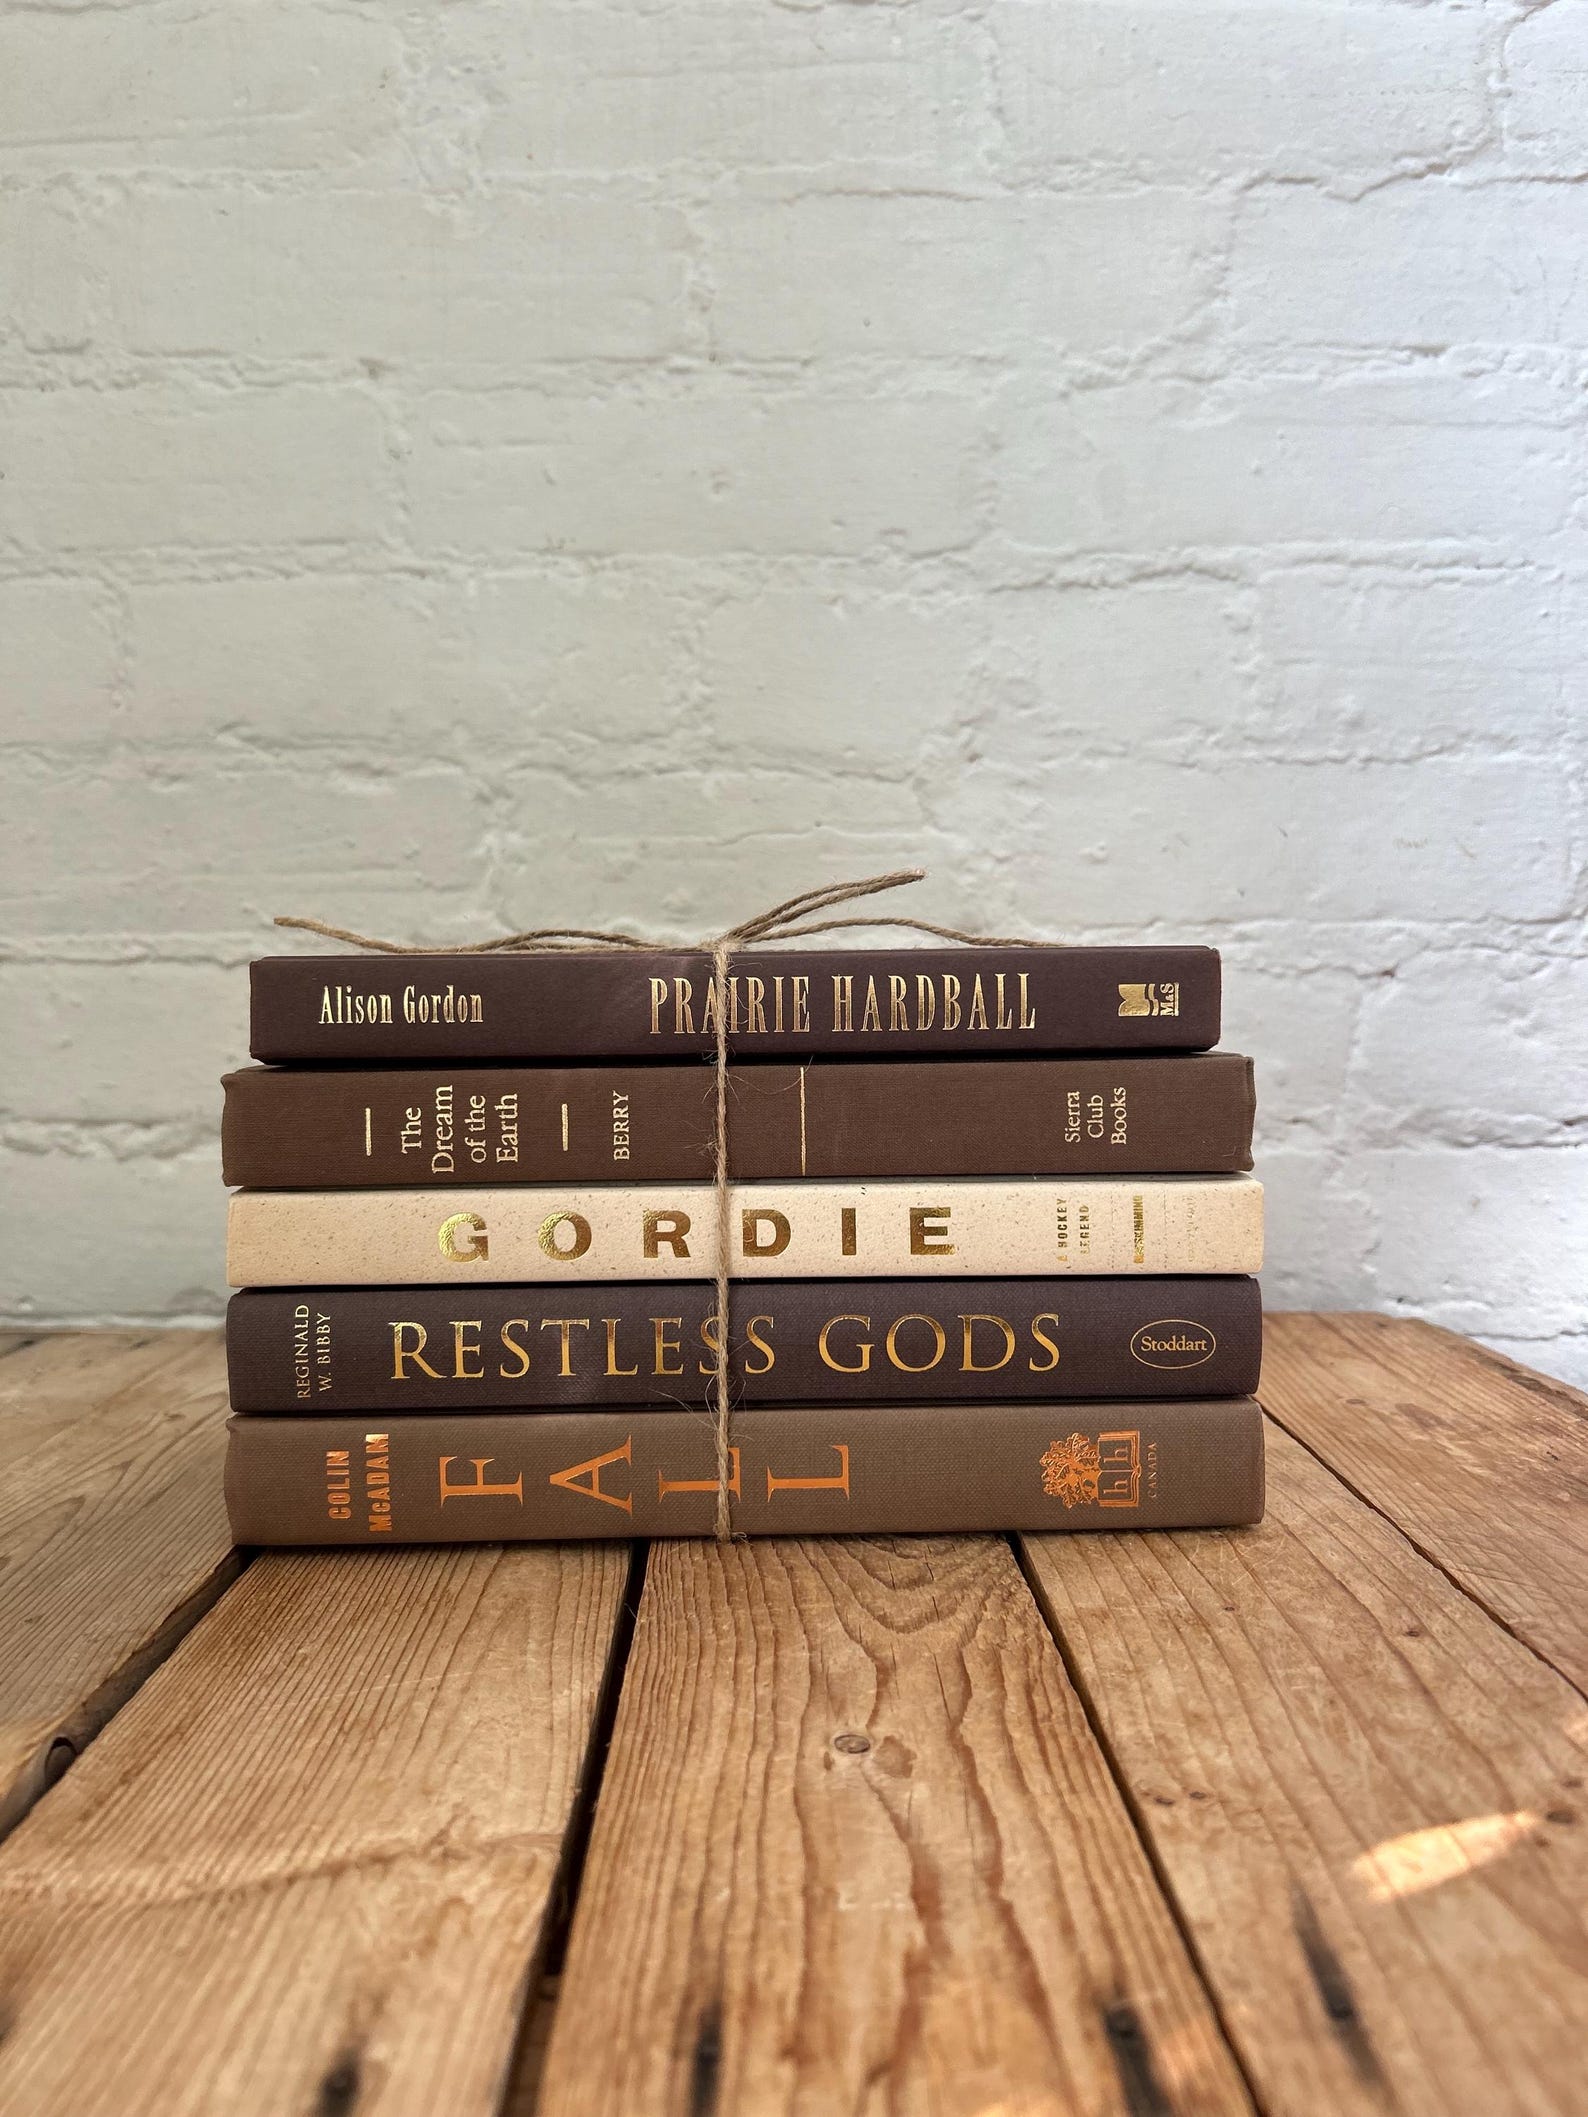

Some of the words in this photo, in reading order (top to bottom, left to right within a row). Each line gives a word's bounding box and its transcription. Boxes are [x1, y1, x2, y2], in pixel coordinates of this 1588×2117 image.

[319, 985, 394, 1025] Alison
[402, 985, 485, 1024] Gordon
[649, 975, 811, 1034] PRAIRIE
[831, 972, 1037, 1032] HARDBALL
[1160, 982, 1175, 1016] M&S
[401, 1106, 422, 1154] The
[431, 1084, 454, 1174] Dream
[464, 1094, 486, 1131] the
[495, 1093, 518, 1163] Earth
[613, 1090, 629, 1161] BERRY
[1065, 1090, 1082, 1143] Sierra
[1087, 1094, 1103, 1138] Club
[1110, 1086, 1127, 1145] Books
[465, 1137, 486, 1163] of
[437, 1206, 956, 1263] GORDIE
[295, 1304, 310, 1399] REGINALD
[317, 1312, 331, 1369] BIBBY
[388, 1315, 776, 1380] RESTLESS
[818, 1312, 1062, 1374] GODS
[1140, 1335, 1207, 1352] Stoddart
[318, 1370, 332, 1393] W.
[326, 1450, 352, 1519] COLIN
[365, 1433, 393, 1533] McADAM
[1147, 1441, 1158, 1499] CANADA
